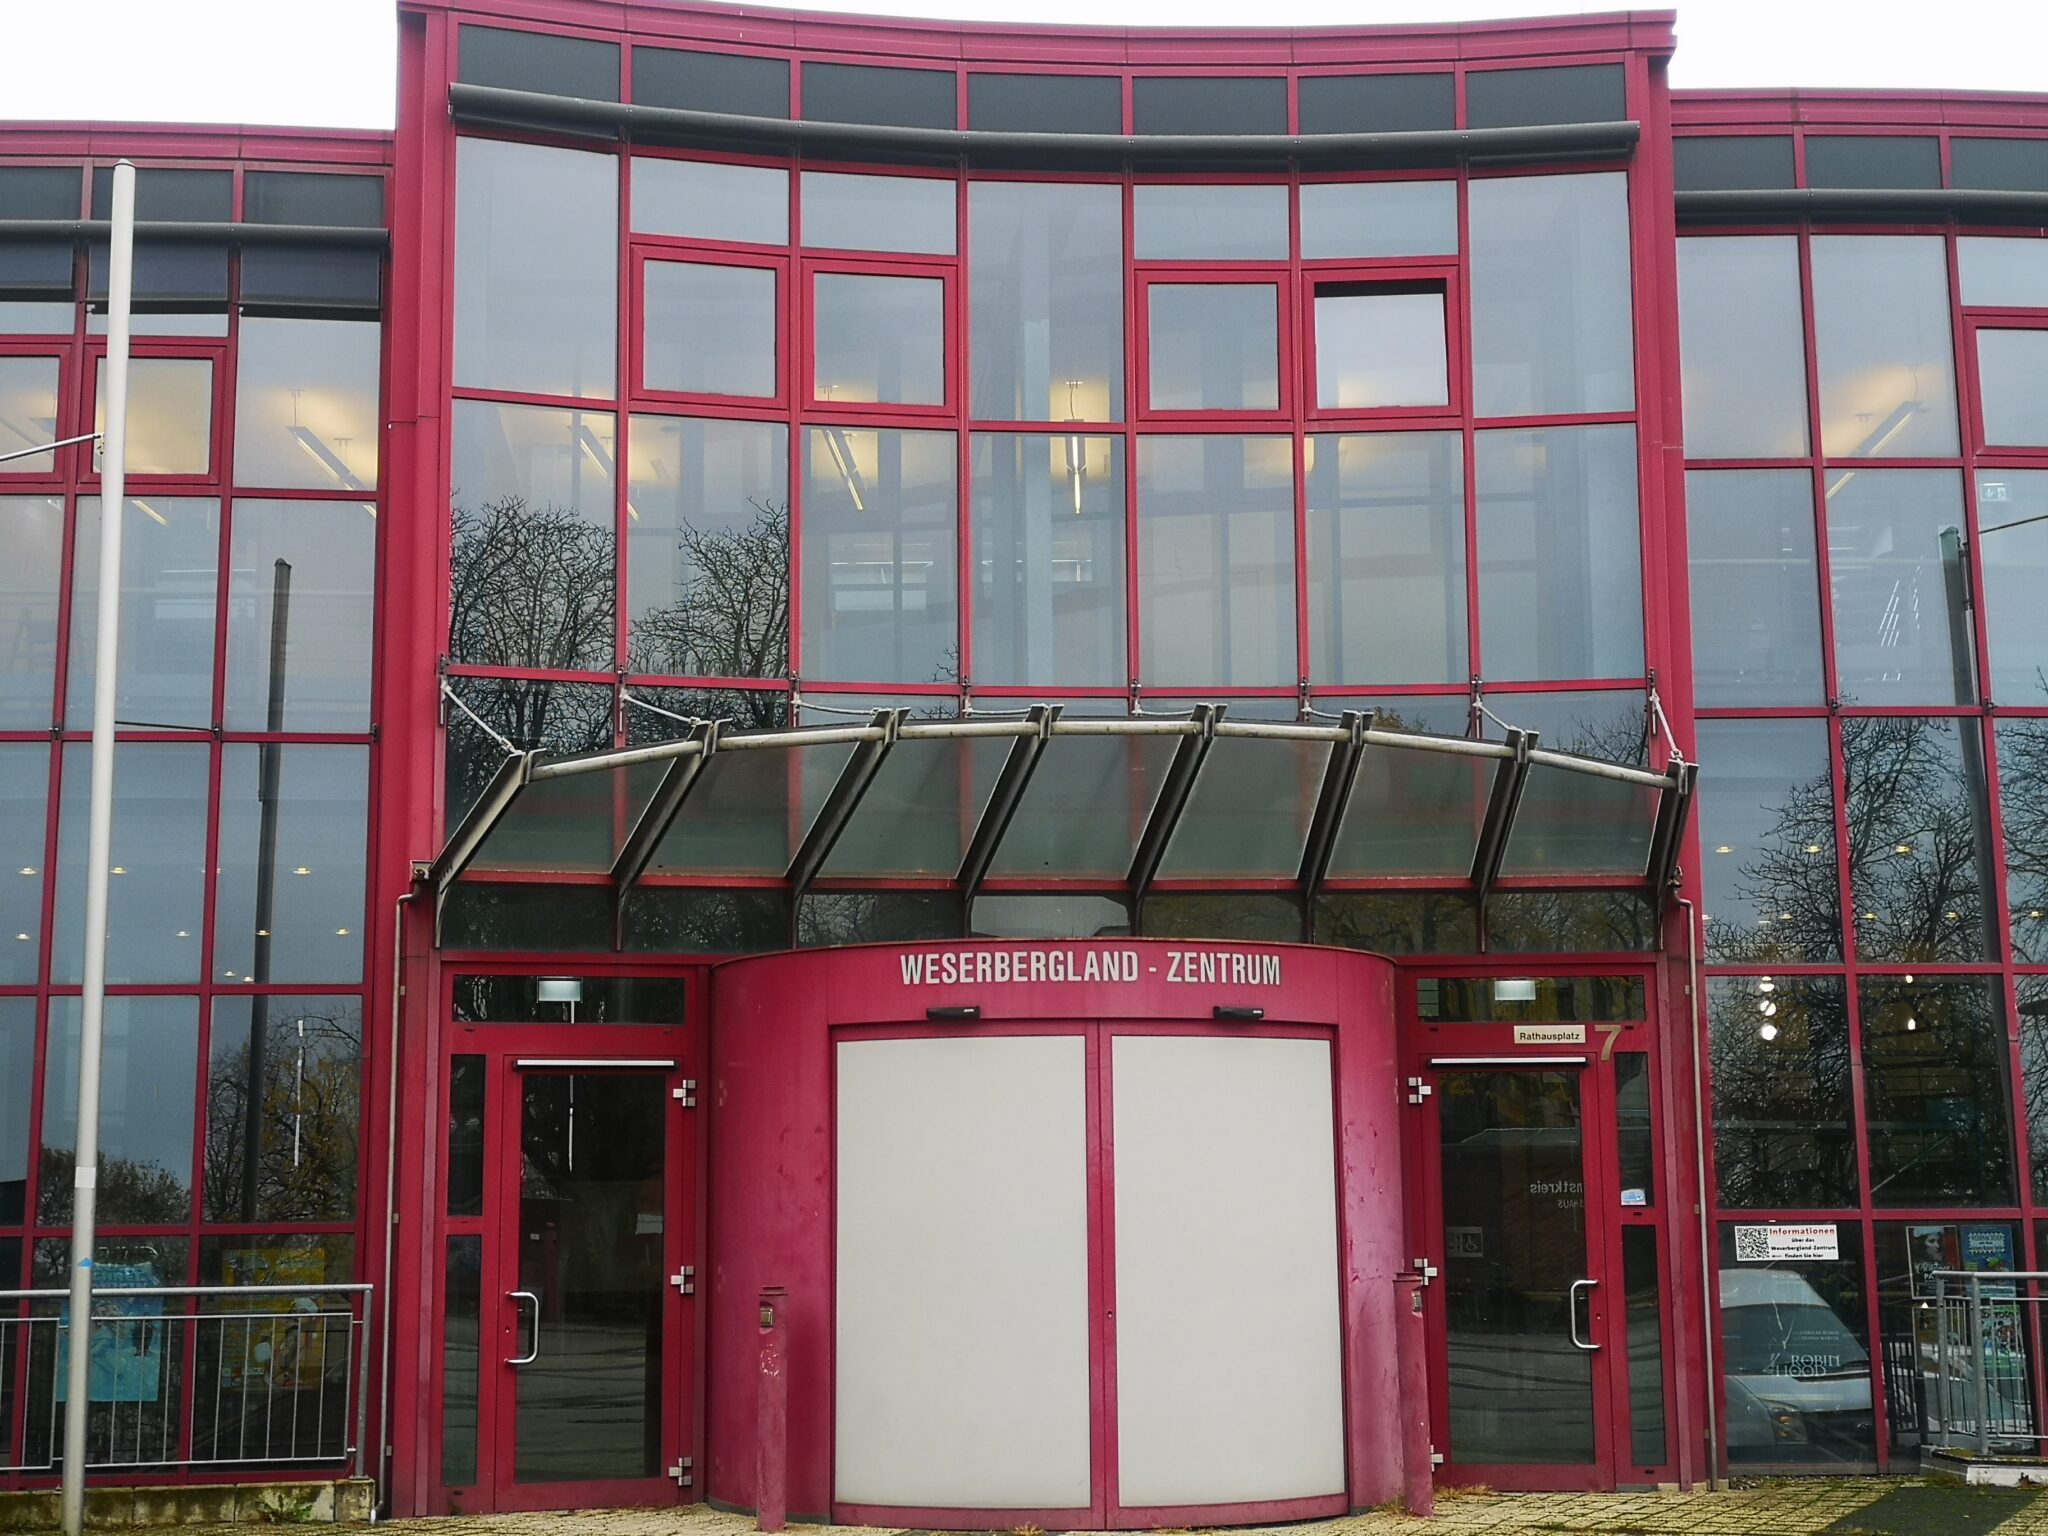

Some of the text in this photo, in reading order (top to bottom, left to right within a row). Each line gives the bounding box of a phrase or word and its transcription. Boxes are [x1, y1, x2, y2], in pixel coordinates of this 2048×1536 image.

[900, 950, 1139, 985] WESERBERGLAND
[1167, 951, 1281, 985] ZENTRUM
[1519, 1032, 1580, 1042] Rathausplatz
[1594, 1024, 1621, 1060] 7
[1791, 1354, 1841, 1367] ROBIN
[1776, 1365, 1827, 1377] HOOD
